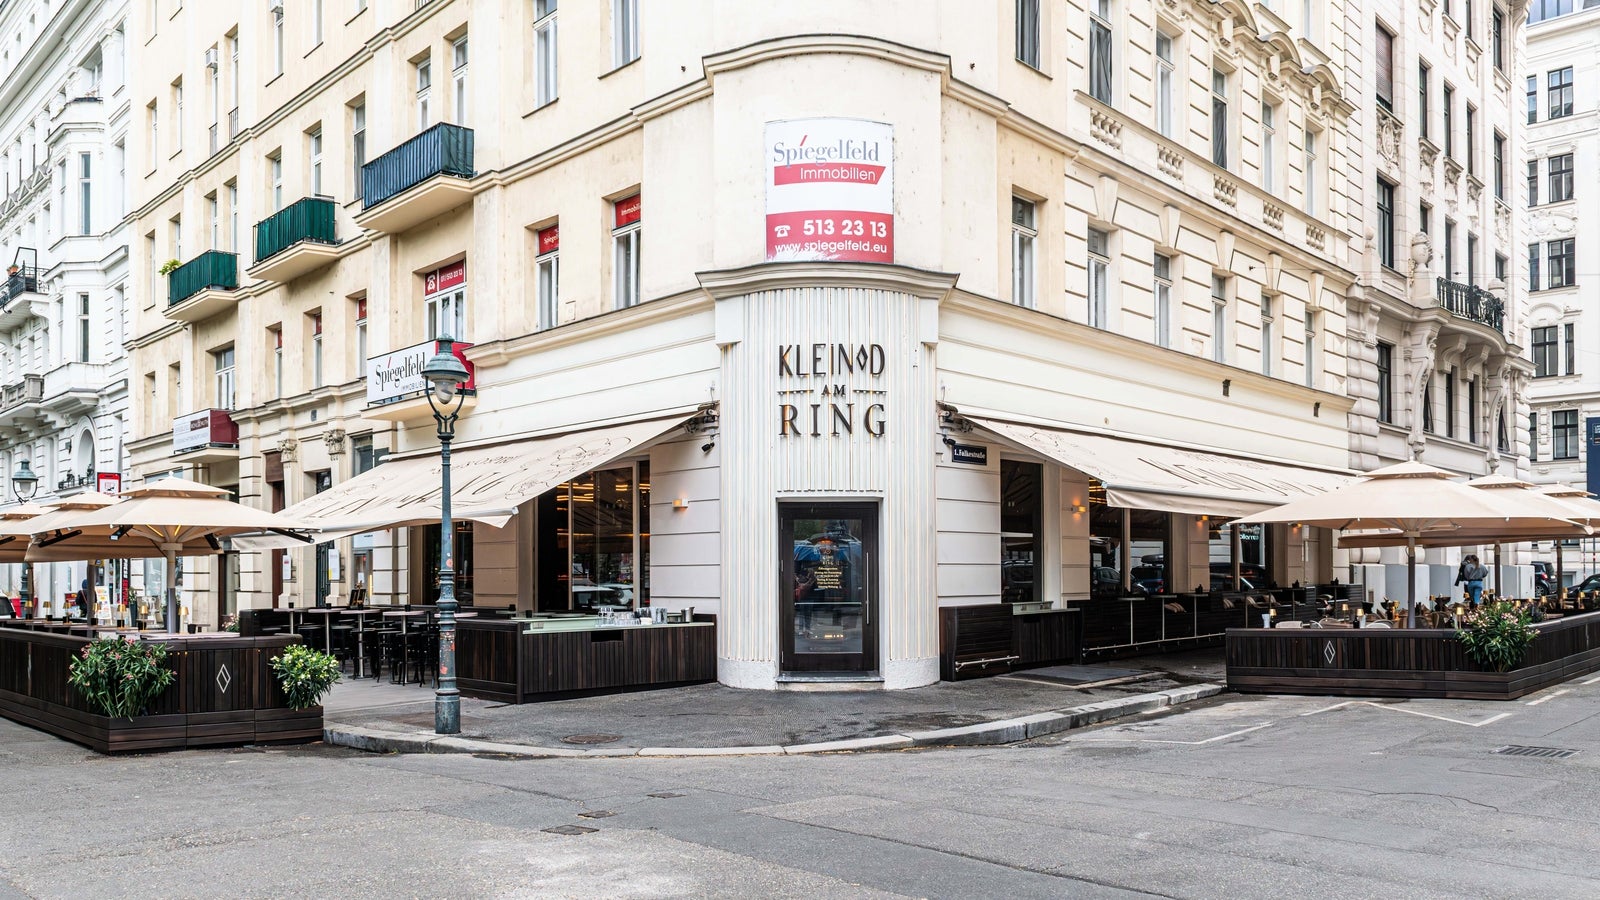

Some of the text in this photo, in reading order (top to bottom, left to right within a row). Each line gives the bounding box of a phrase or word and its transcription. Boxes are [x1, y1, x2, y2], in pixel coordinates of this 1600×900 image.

[800, 167, 876, 181] Immobilien
[803, 219, 888, 238] 513 23 13
[774, 240, 888, 254] www.spiegelfeld.eu
[779, 344, 886, 376] KLEINOD
[821, 384, 846, 397] AM
[778, 403, 887, 436] RING
